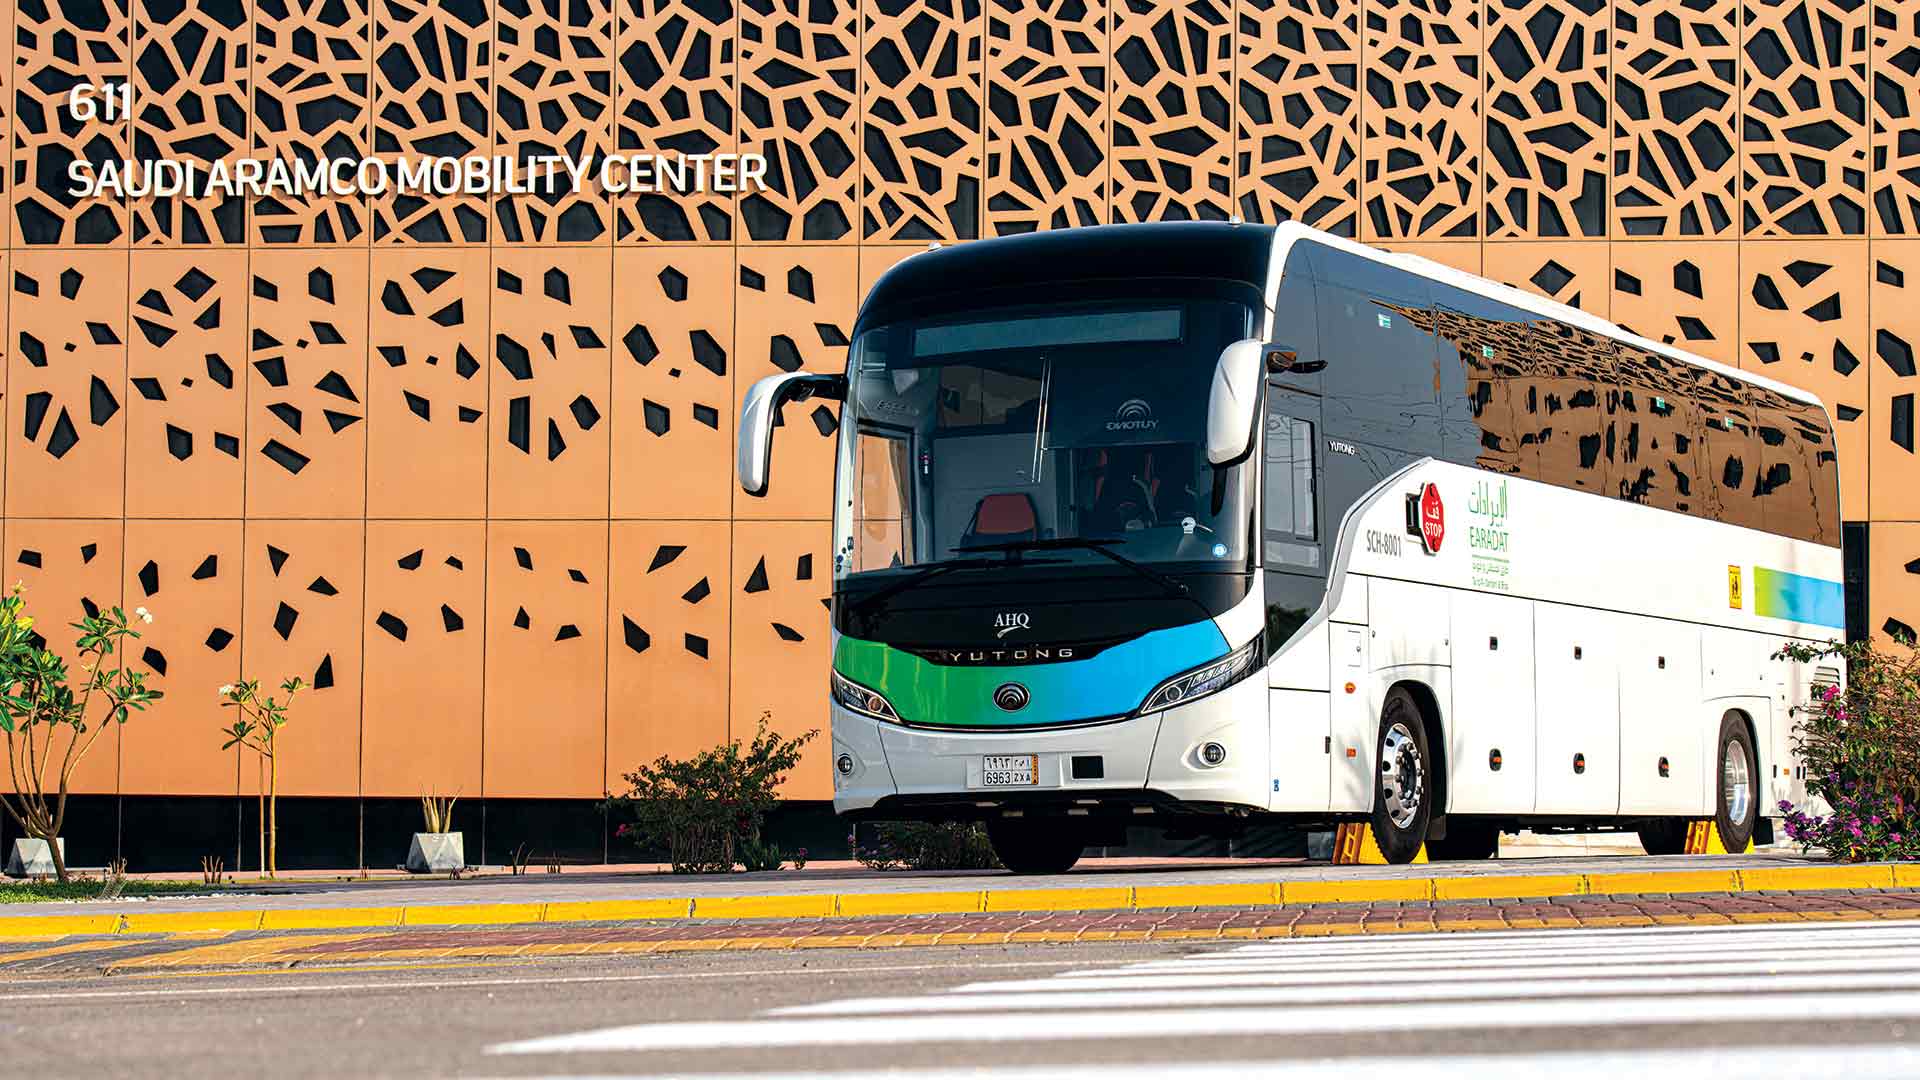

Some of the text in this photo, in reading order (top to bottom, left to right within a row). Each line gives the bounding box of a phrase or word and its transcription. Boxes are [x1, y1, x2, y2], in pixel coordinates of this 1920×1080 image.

[69, 83, 131, 121] 611
[67, 153, 768, 198] SAUDI ARAMCO MOBILITY CENTER
[1425, 521, 1442, 537] STOP
[1469, 526, 1509, 552] EARADAT
[1366, 529, 1402, 558] SCH-8001
[994, 612, 1031, 629] AHQ
[950, 648, 1073, 662] YUTONG
[986, 771, 1011, 784] 6963
